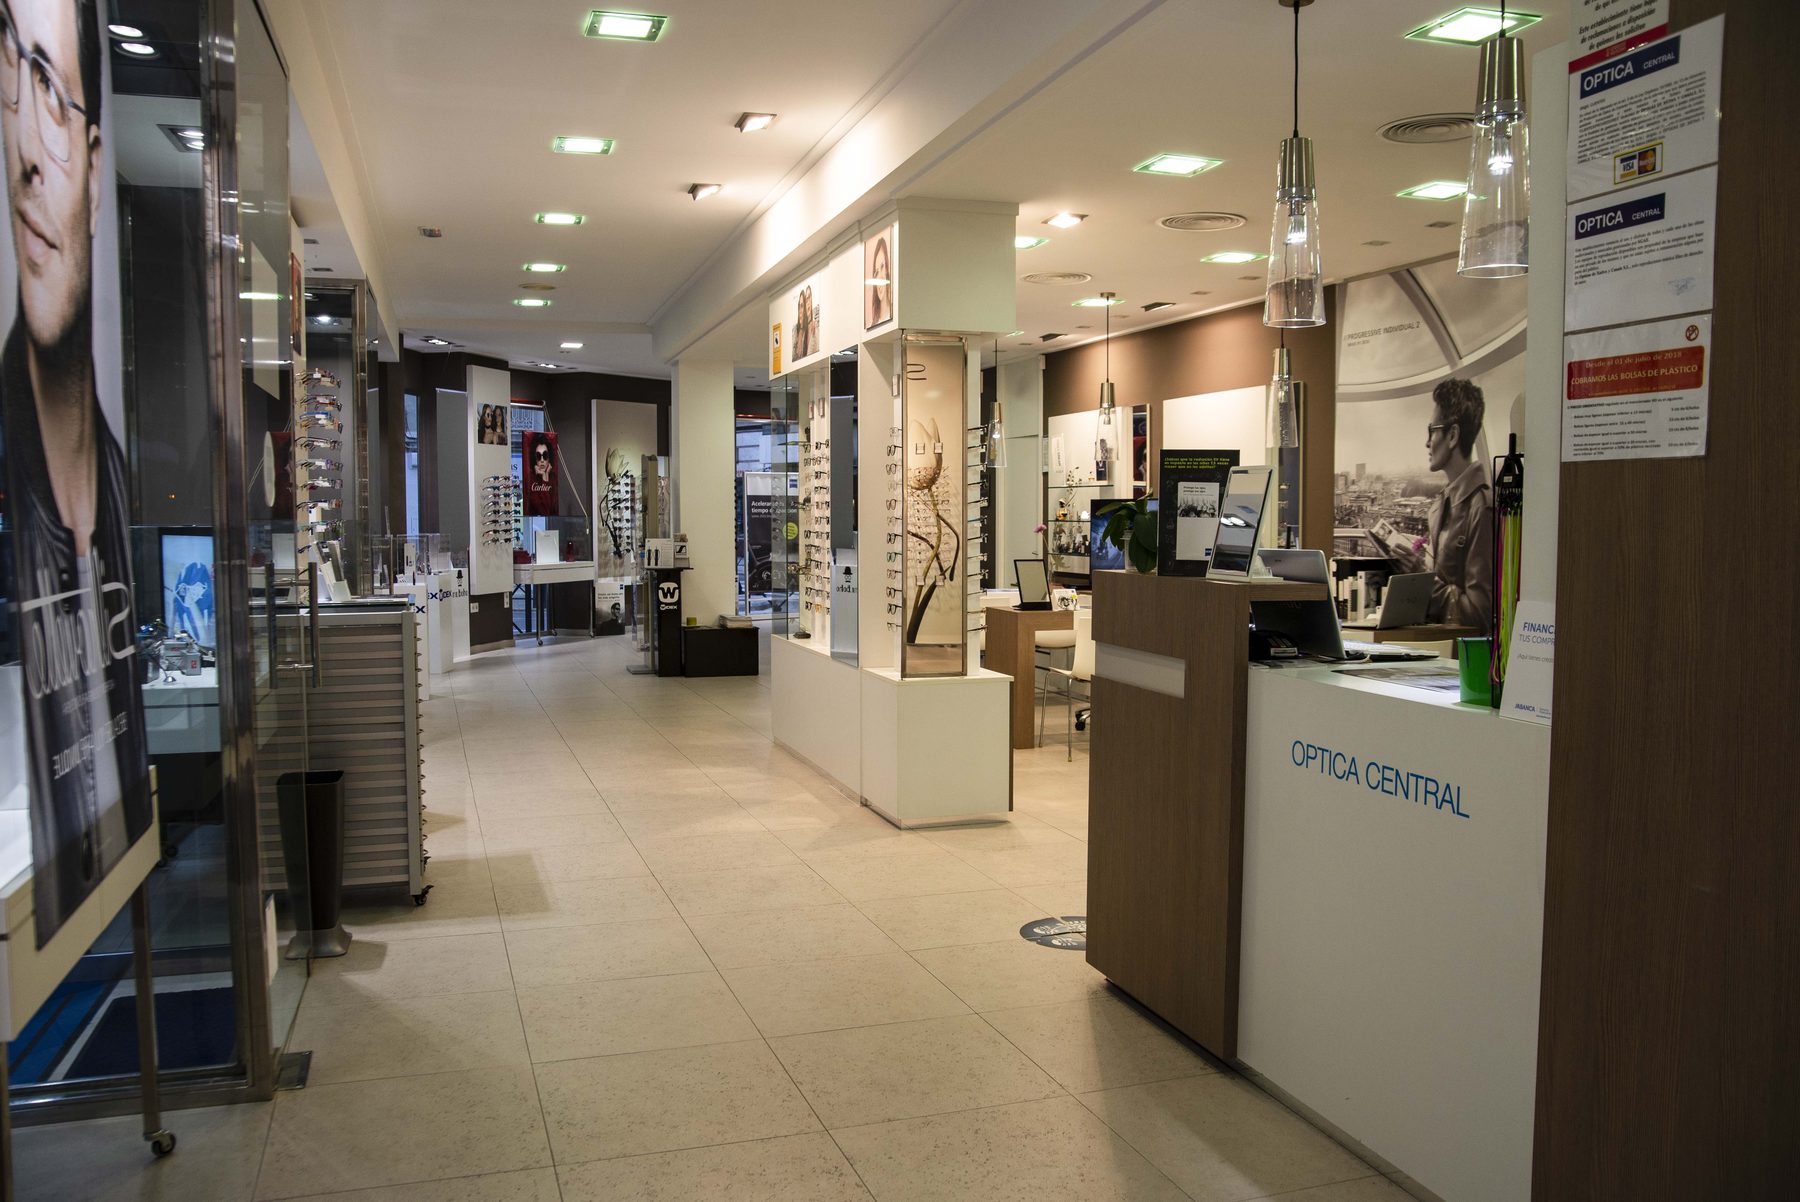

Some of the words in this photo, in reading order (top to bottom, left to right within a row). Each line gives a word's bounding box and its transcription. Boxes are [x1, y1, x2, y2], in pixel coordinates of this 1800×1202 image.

[1583, 61, 1634, 92] OPTICA
[1643, 52, 1676, 70] CENTRAL
[1577, 210, 1624, 234] OPTICA
[1631, 207, 1661, 221] CENTRAL
[1347, 328, 1382, 340] PROGRESSIVE
[1383, 322, 1415, 334] INDIVIDUAL
[1585, 360, 1604, 368] Desde
[1571, 374, 1606, 385] COBRAMOS
[1620, 370, 1646, 379] BOLSAS
[531, 482, 552, 492] Cartier
[1523, 622, 1555, 634] FINANC
[1519, 634, 1531, 643] TUS
[1291, 740, 1359, 785] OPTICA
[1365, 761, 1470, 819] CENTRAL
